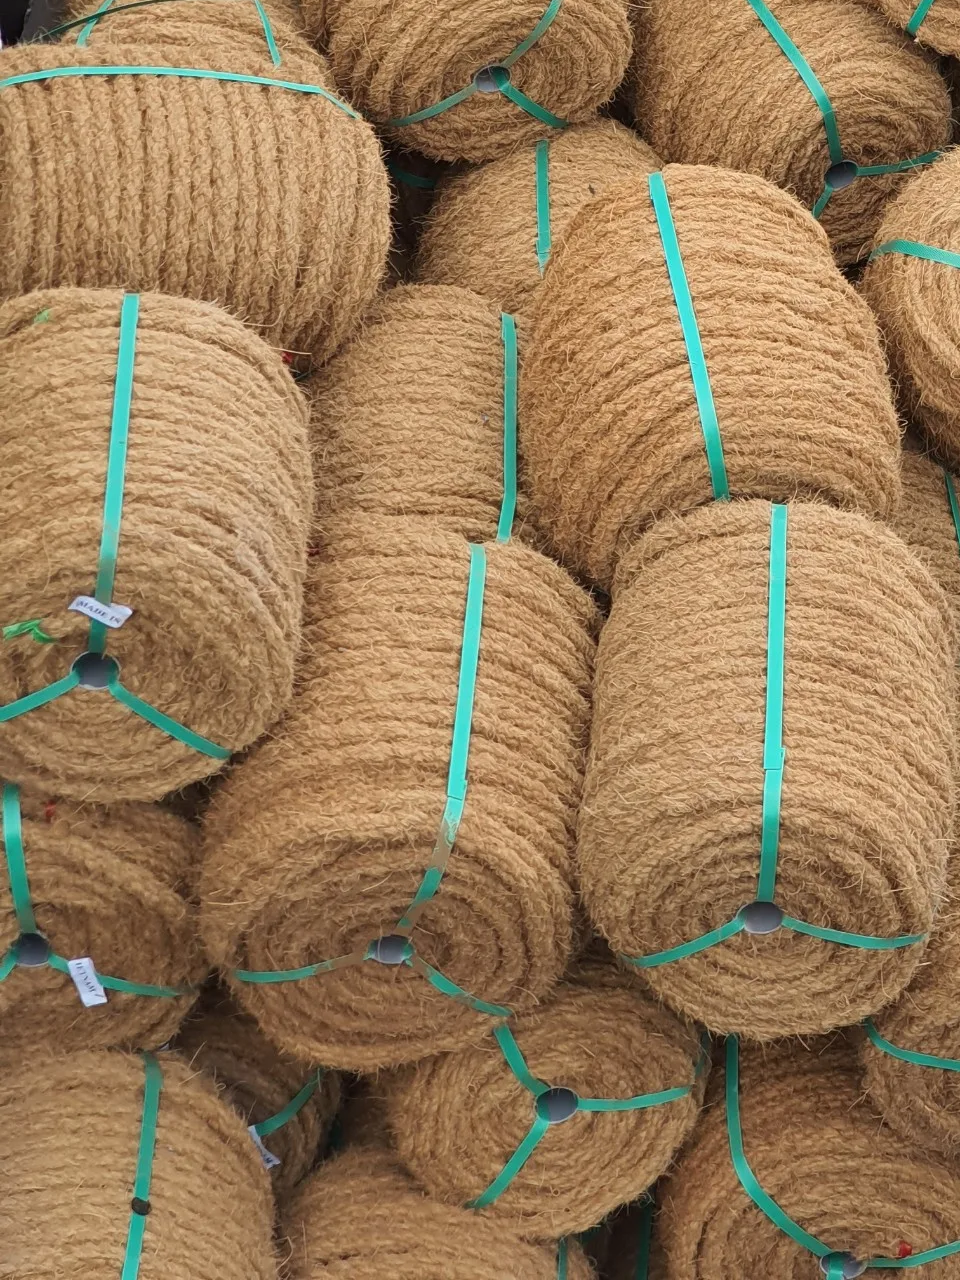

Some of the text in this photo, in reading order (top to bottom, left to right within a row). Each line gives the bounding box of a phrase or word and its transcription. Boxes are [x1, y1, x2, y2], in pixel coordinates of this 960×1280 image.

[76, 600, 121, 624] MADE IN
[75, 962, 97, 993] IETNAM
